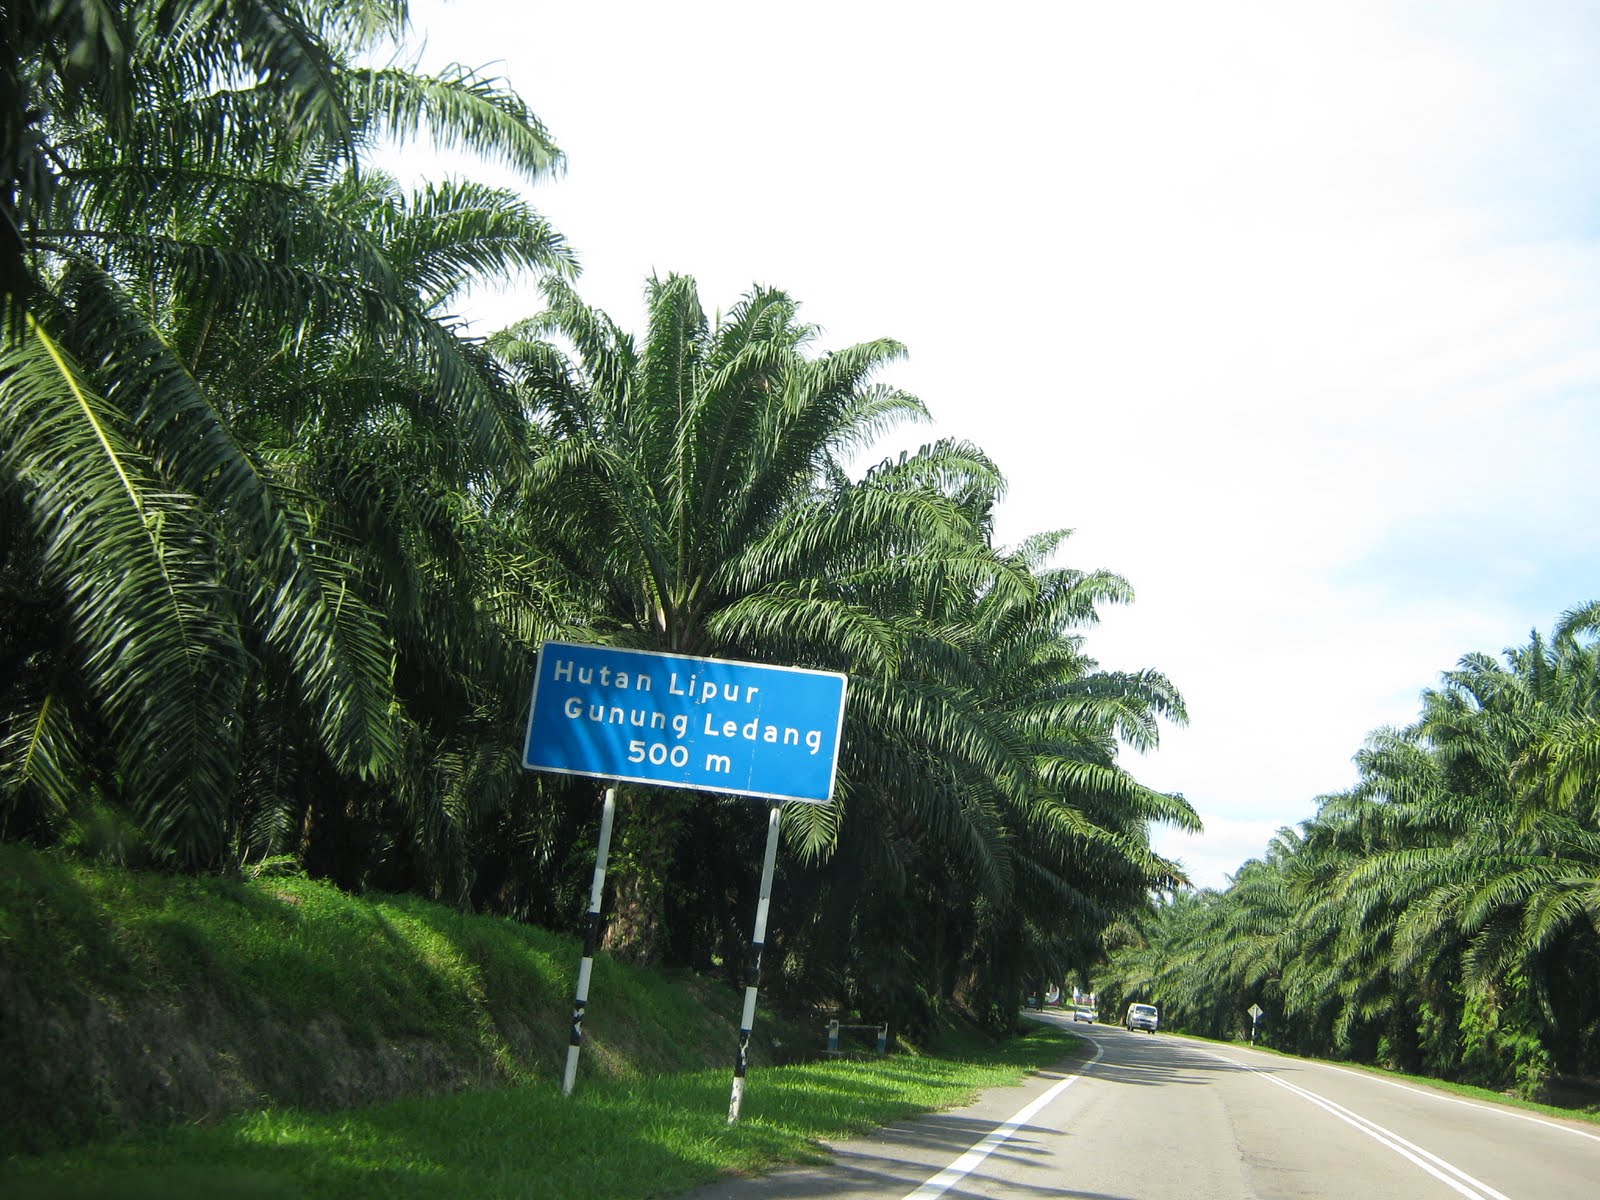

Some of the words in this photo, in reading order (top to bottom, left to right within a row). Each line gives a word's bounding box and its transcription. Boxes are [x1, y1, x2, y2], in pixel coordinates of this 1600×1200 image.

[554, 660, 652, 692] Hutan
[669, 673, 759, 704] Lipur
[564, 697, 688, 738] Gunung
[704, 713, 822, 755] Ledang
[627, 740, 689, 768] 500
[705, 753, 731, 774] m
